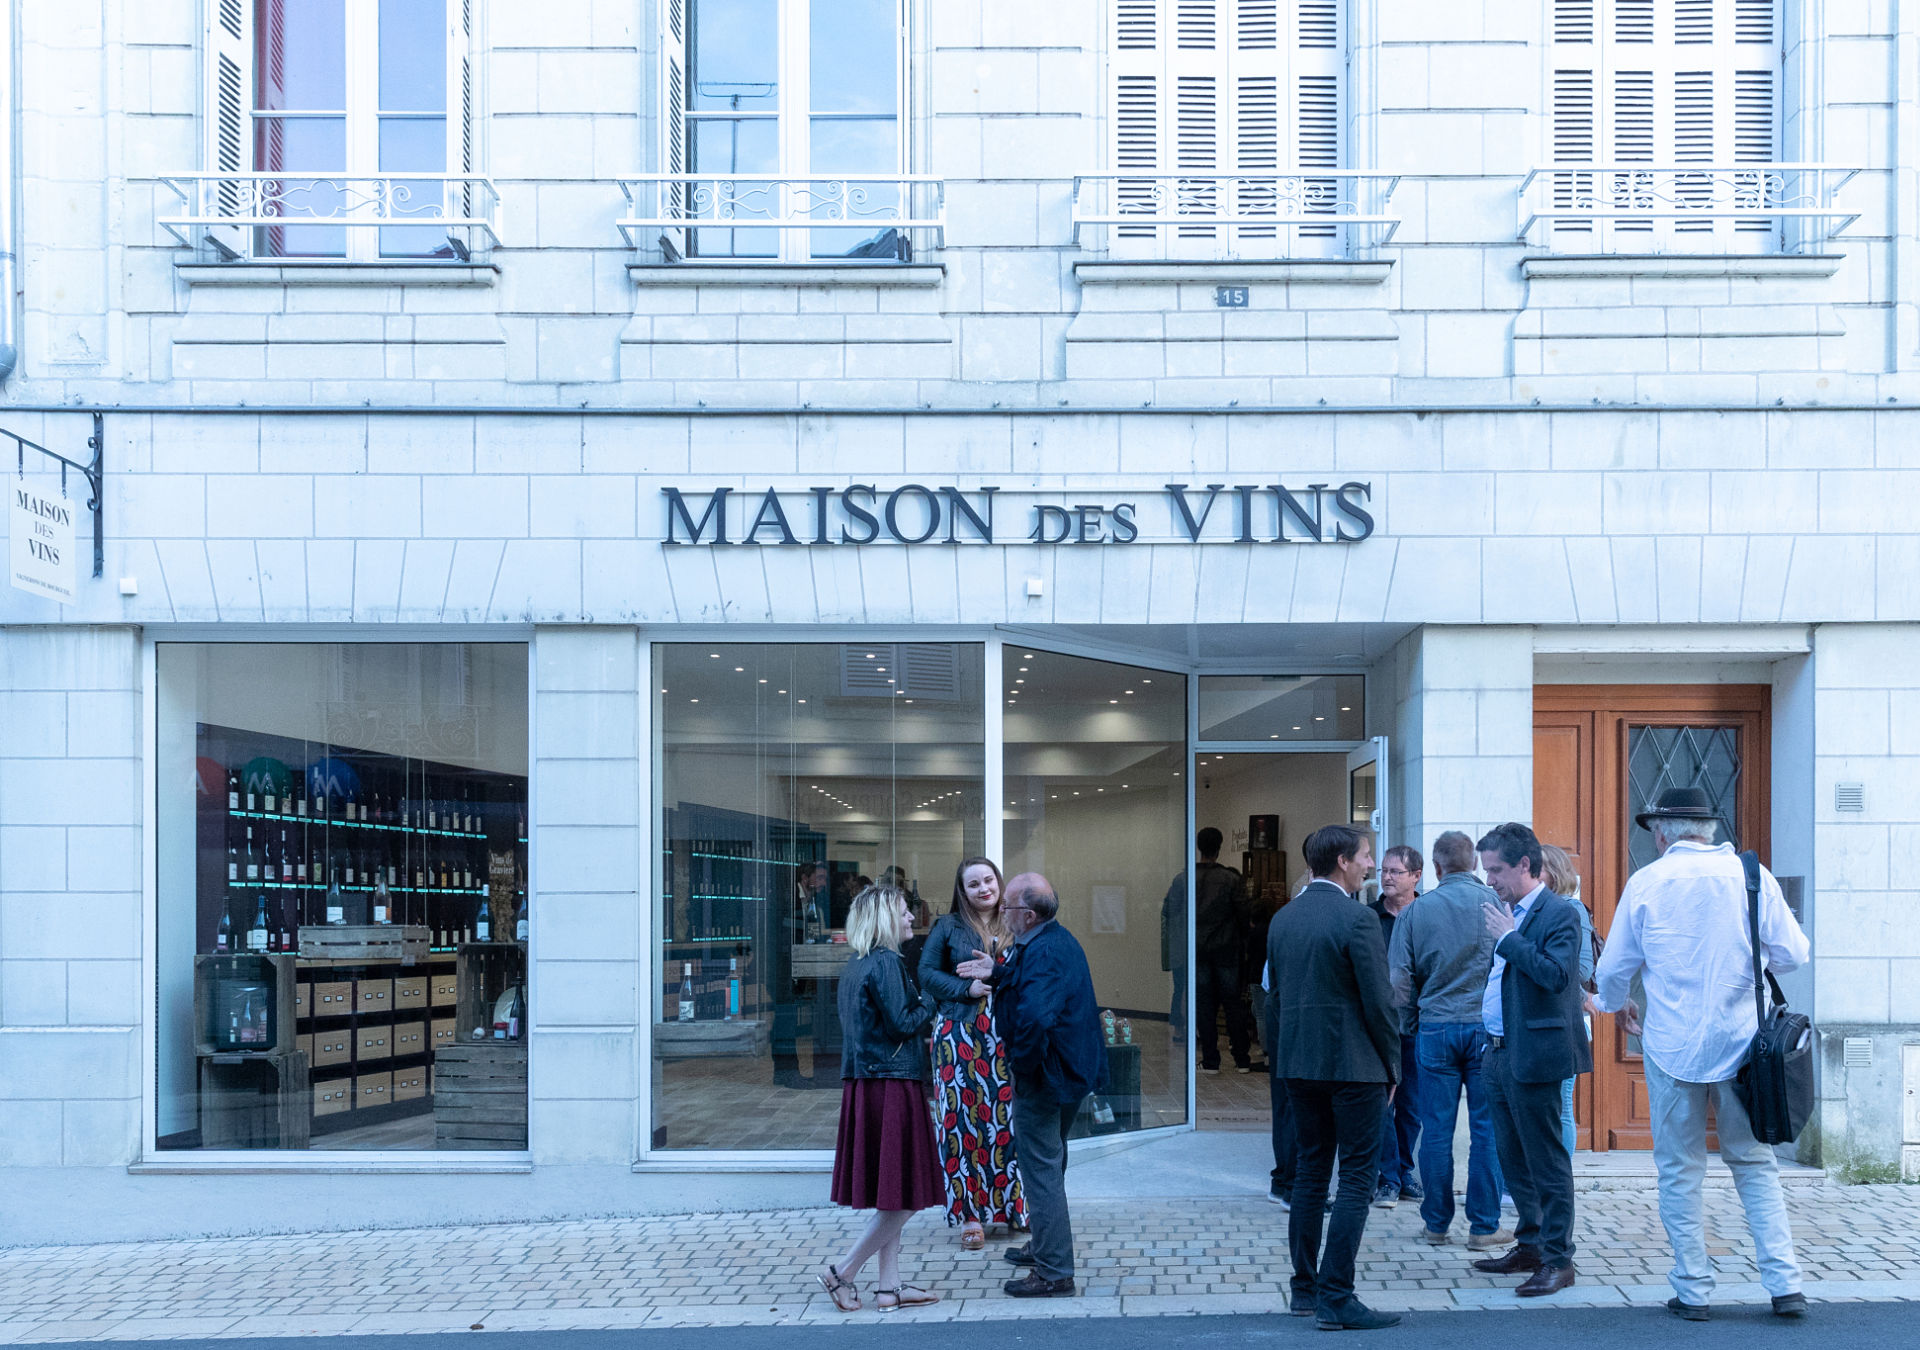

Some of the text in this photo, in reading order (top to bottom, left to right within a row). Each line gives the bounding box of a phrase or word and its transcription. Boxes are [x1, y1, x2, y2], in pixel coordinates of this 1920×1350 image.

[1223, 290, 1244, 304] 15
[17, 489, 70, 527] MAISON
[660, 481, 1375, 545] MAISON DES VINS
[34, 520, 54, 539] DES
[28, 538, 60, 566] VINS
